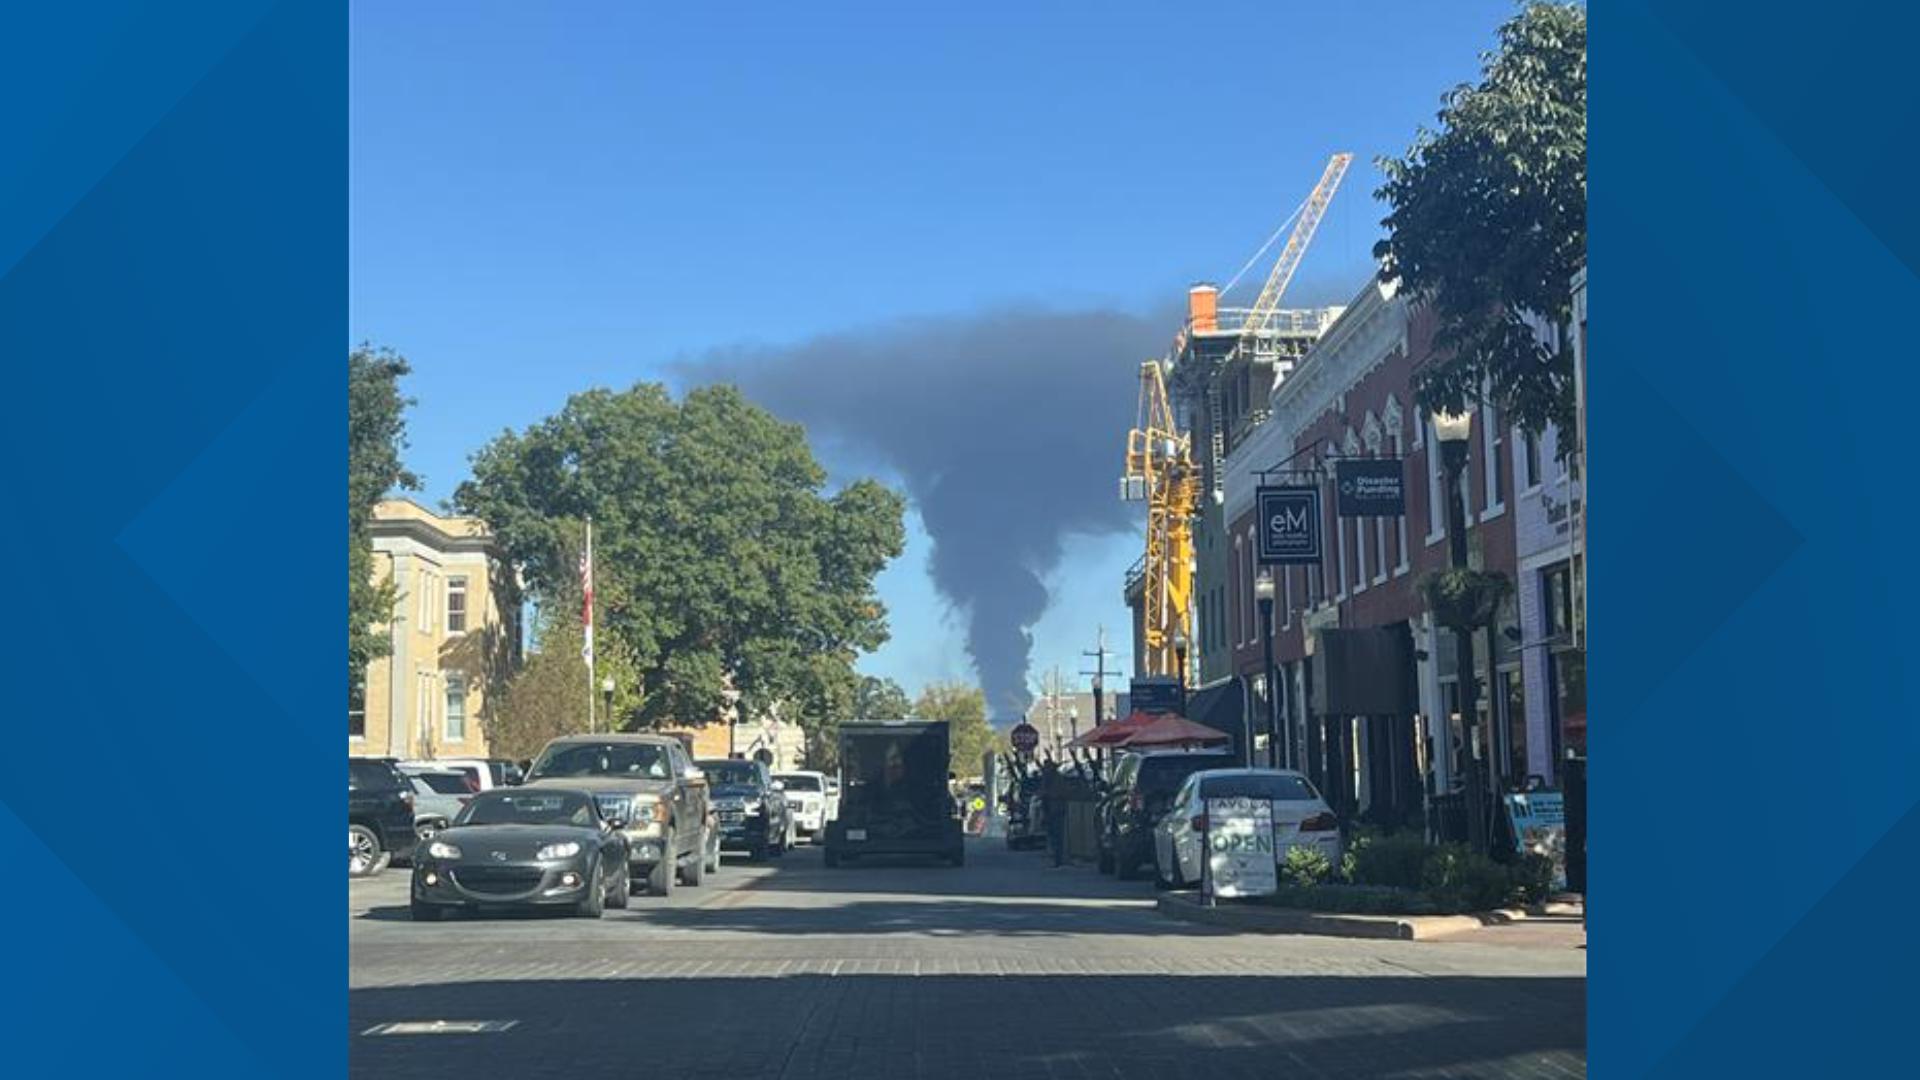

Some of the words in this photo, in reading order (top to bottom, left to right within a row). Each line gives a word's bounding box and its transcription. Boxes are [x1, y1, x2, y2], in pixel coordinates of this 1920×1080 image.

[1357, 476, 1398, 485] Disaster
[1271, 506, 1307, 532] eM
[1213, 834, 1272, 853] OPEN
